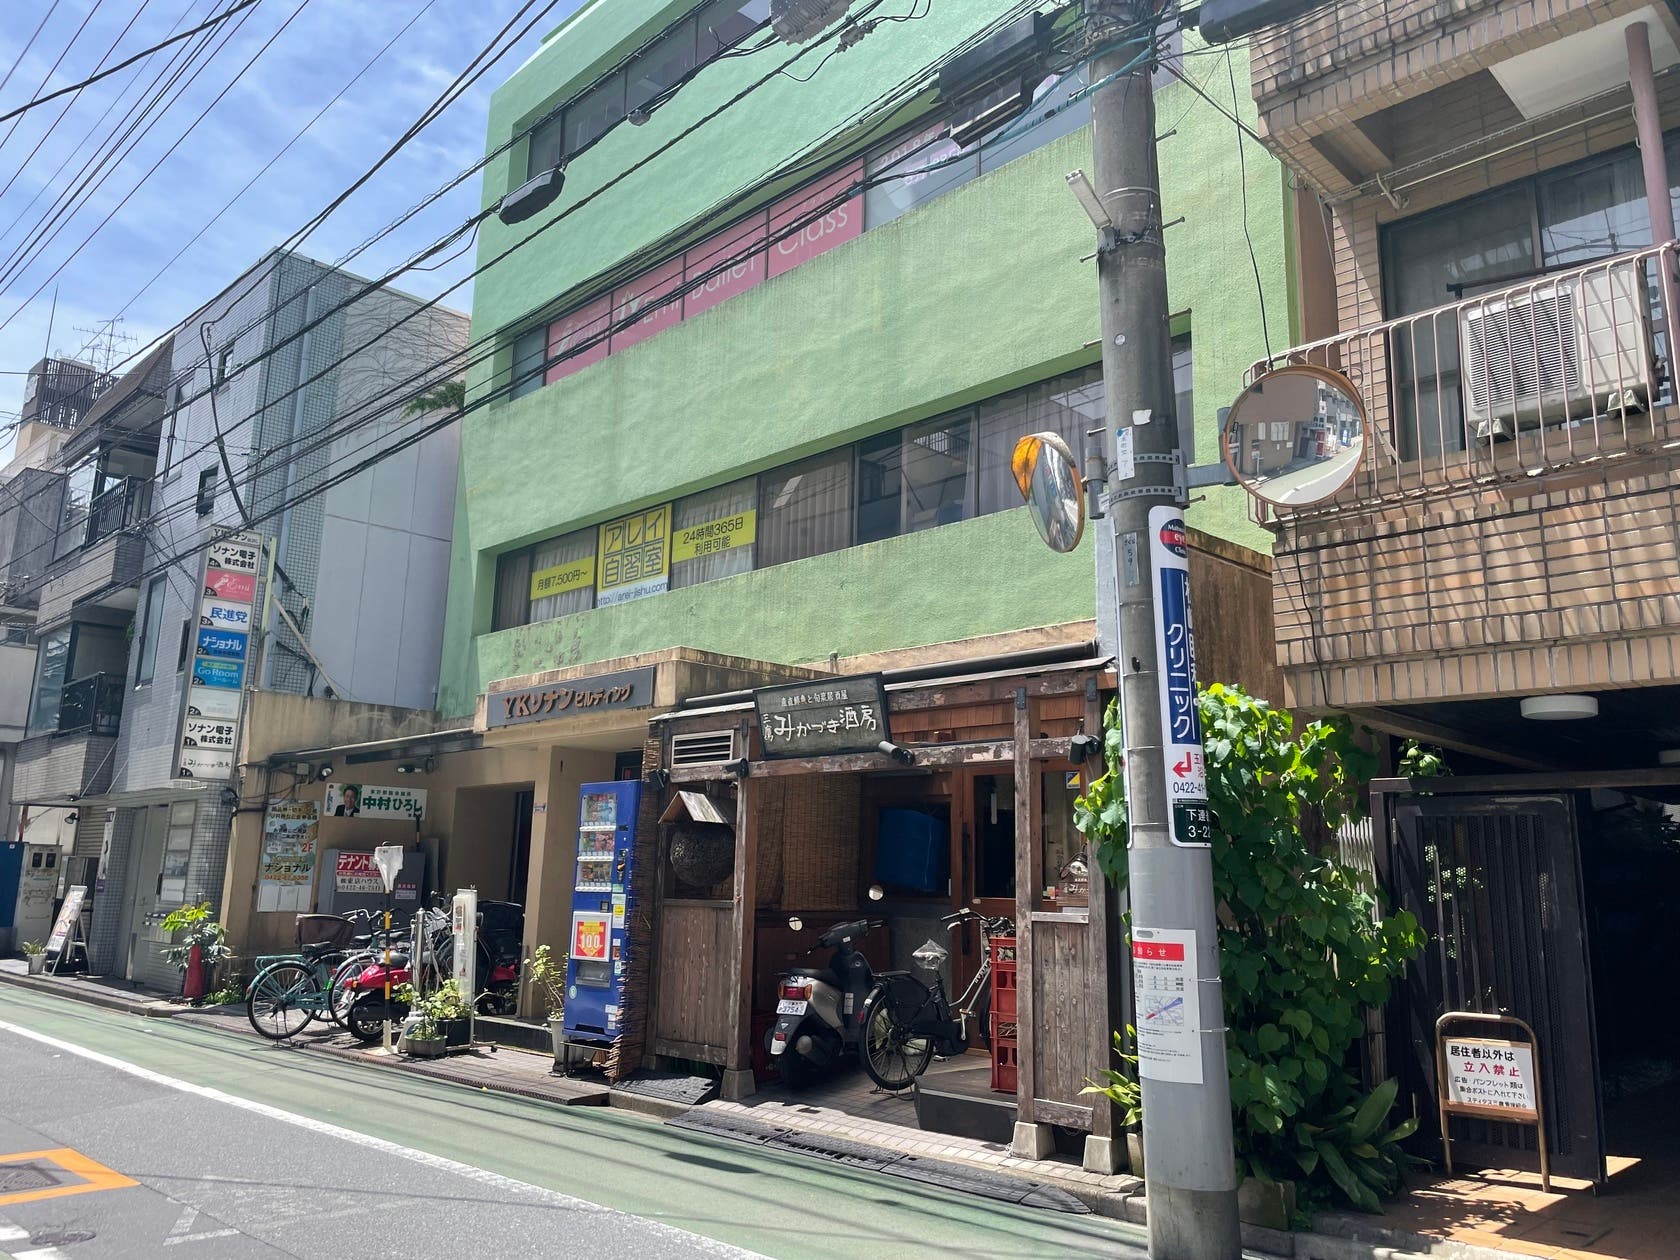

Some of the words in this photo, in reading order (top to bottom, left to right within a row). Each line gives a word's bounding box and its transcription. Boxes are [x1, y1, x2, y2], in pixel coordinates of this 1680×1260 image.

[606, 511, 665, 552] アレイ
[683, 517, 744, 545] 24時間365日
[213, 544, 256, 560] ソナン電子
[694, 537, 731, 556] 利用可能
[224, 557, 255, 569] 株式会社
[604, 547, 663, 585] 自習室
[209, 607, 248, 623] 民進党
[202, 635, 242, 651] ナショナル
[198, 667, 211, 675] Go
[212, 668, 239, 678] Room
[1167, 623, 1192, 740] クリニック
[188, 722, 234, 735] ソナン電子
[773, 704, 877, 742] みかづき酒房
[200, 735, 232, 745] 株式会社
[362, 796, 422, 813] 中村ひろし
[301, 843, 313, 853] 2F
[264, 863, 311, 873] ナショナル
[580, 933, 601, 949] 100
[1450, 1045, 1515, 1062] 居住者以外は
[1463, 1061, 1520, 1077] 立入禁止
